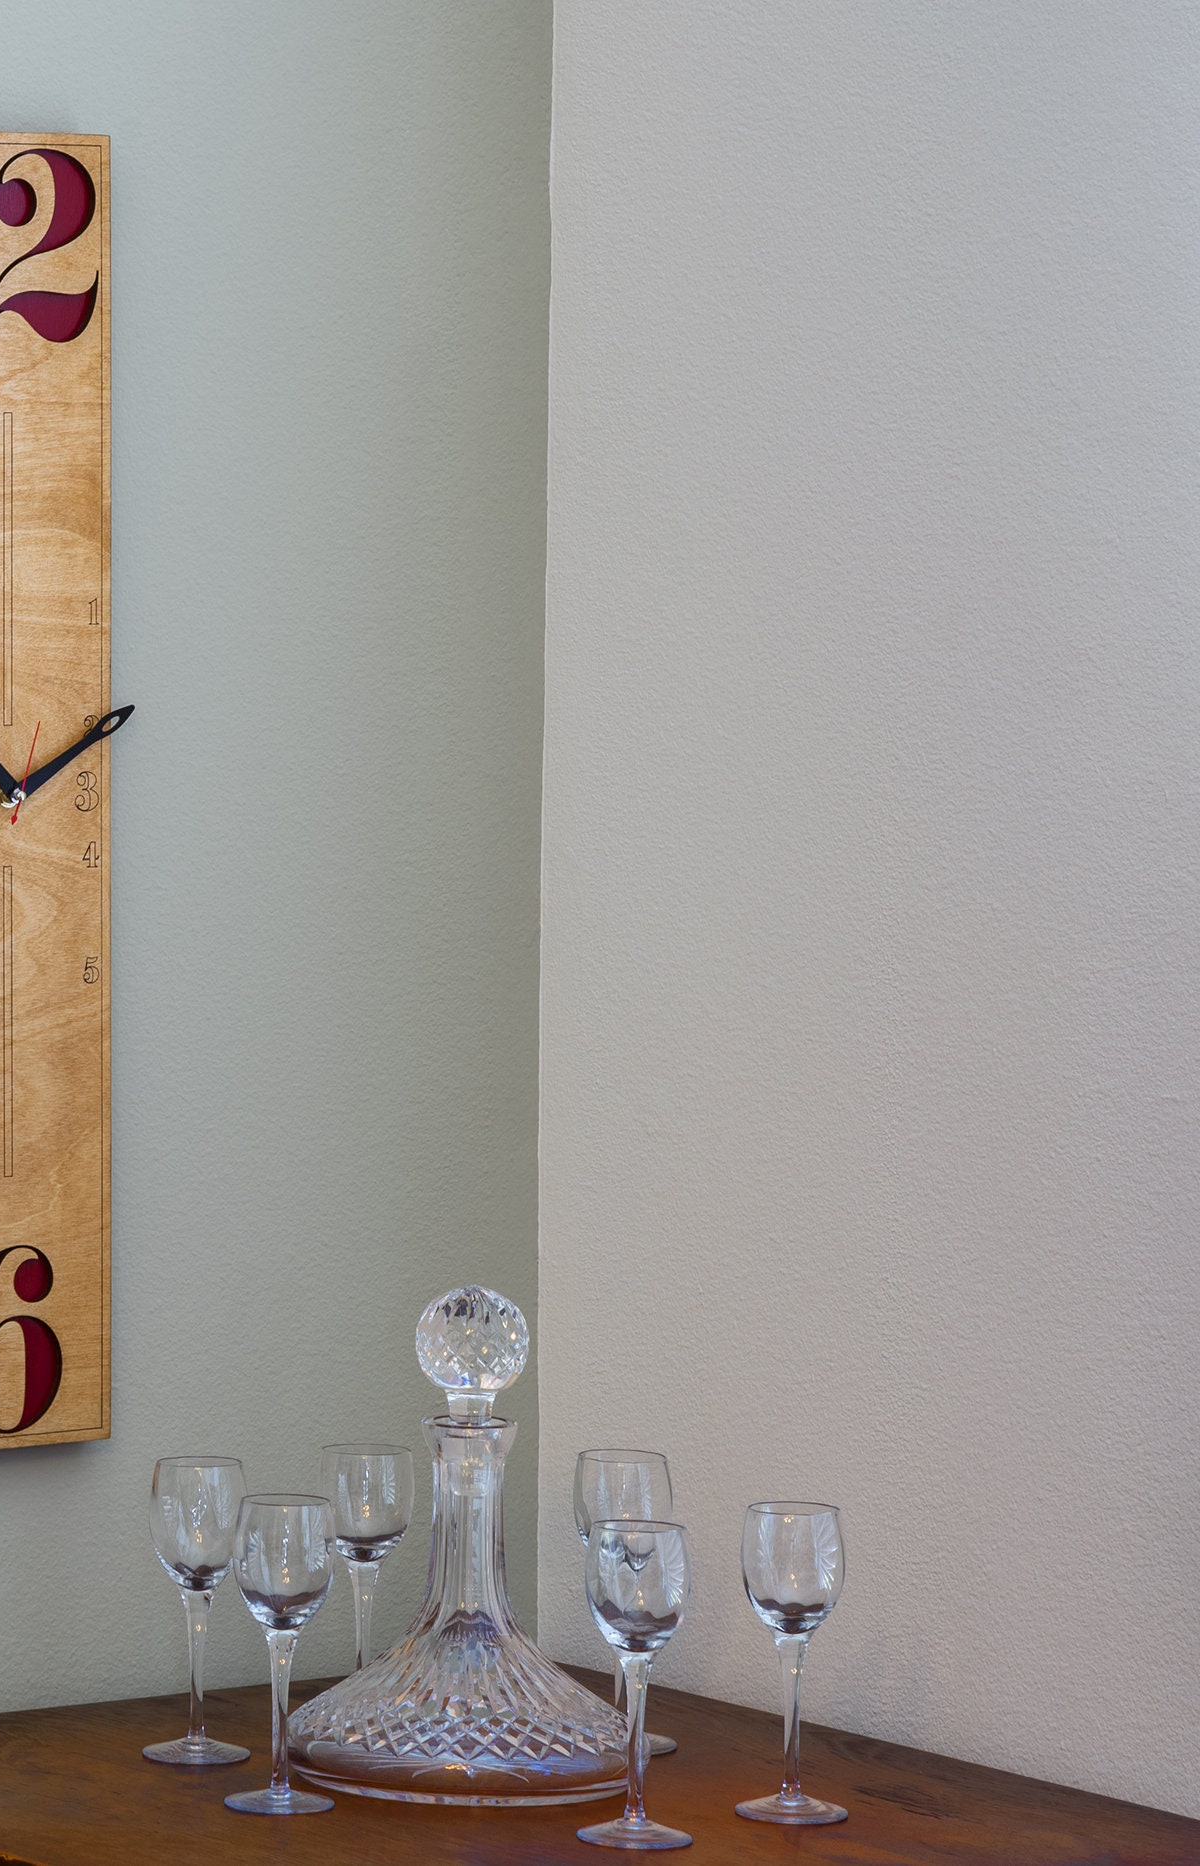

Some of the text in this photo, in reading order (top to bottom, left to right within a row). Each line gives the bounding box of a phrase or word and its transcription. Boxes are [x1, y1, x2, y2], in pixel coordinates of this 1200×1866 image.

[88, 598, 100, 625] 1
[74, 771, 100, 812] 3
[82, 841, 100, 868] 4
[83, 956, 100, 984] 5
